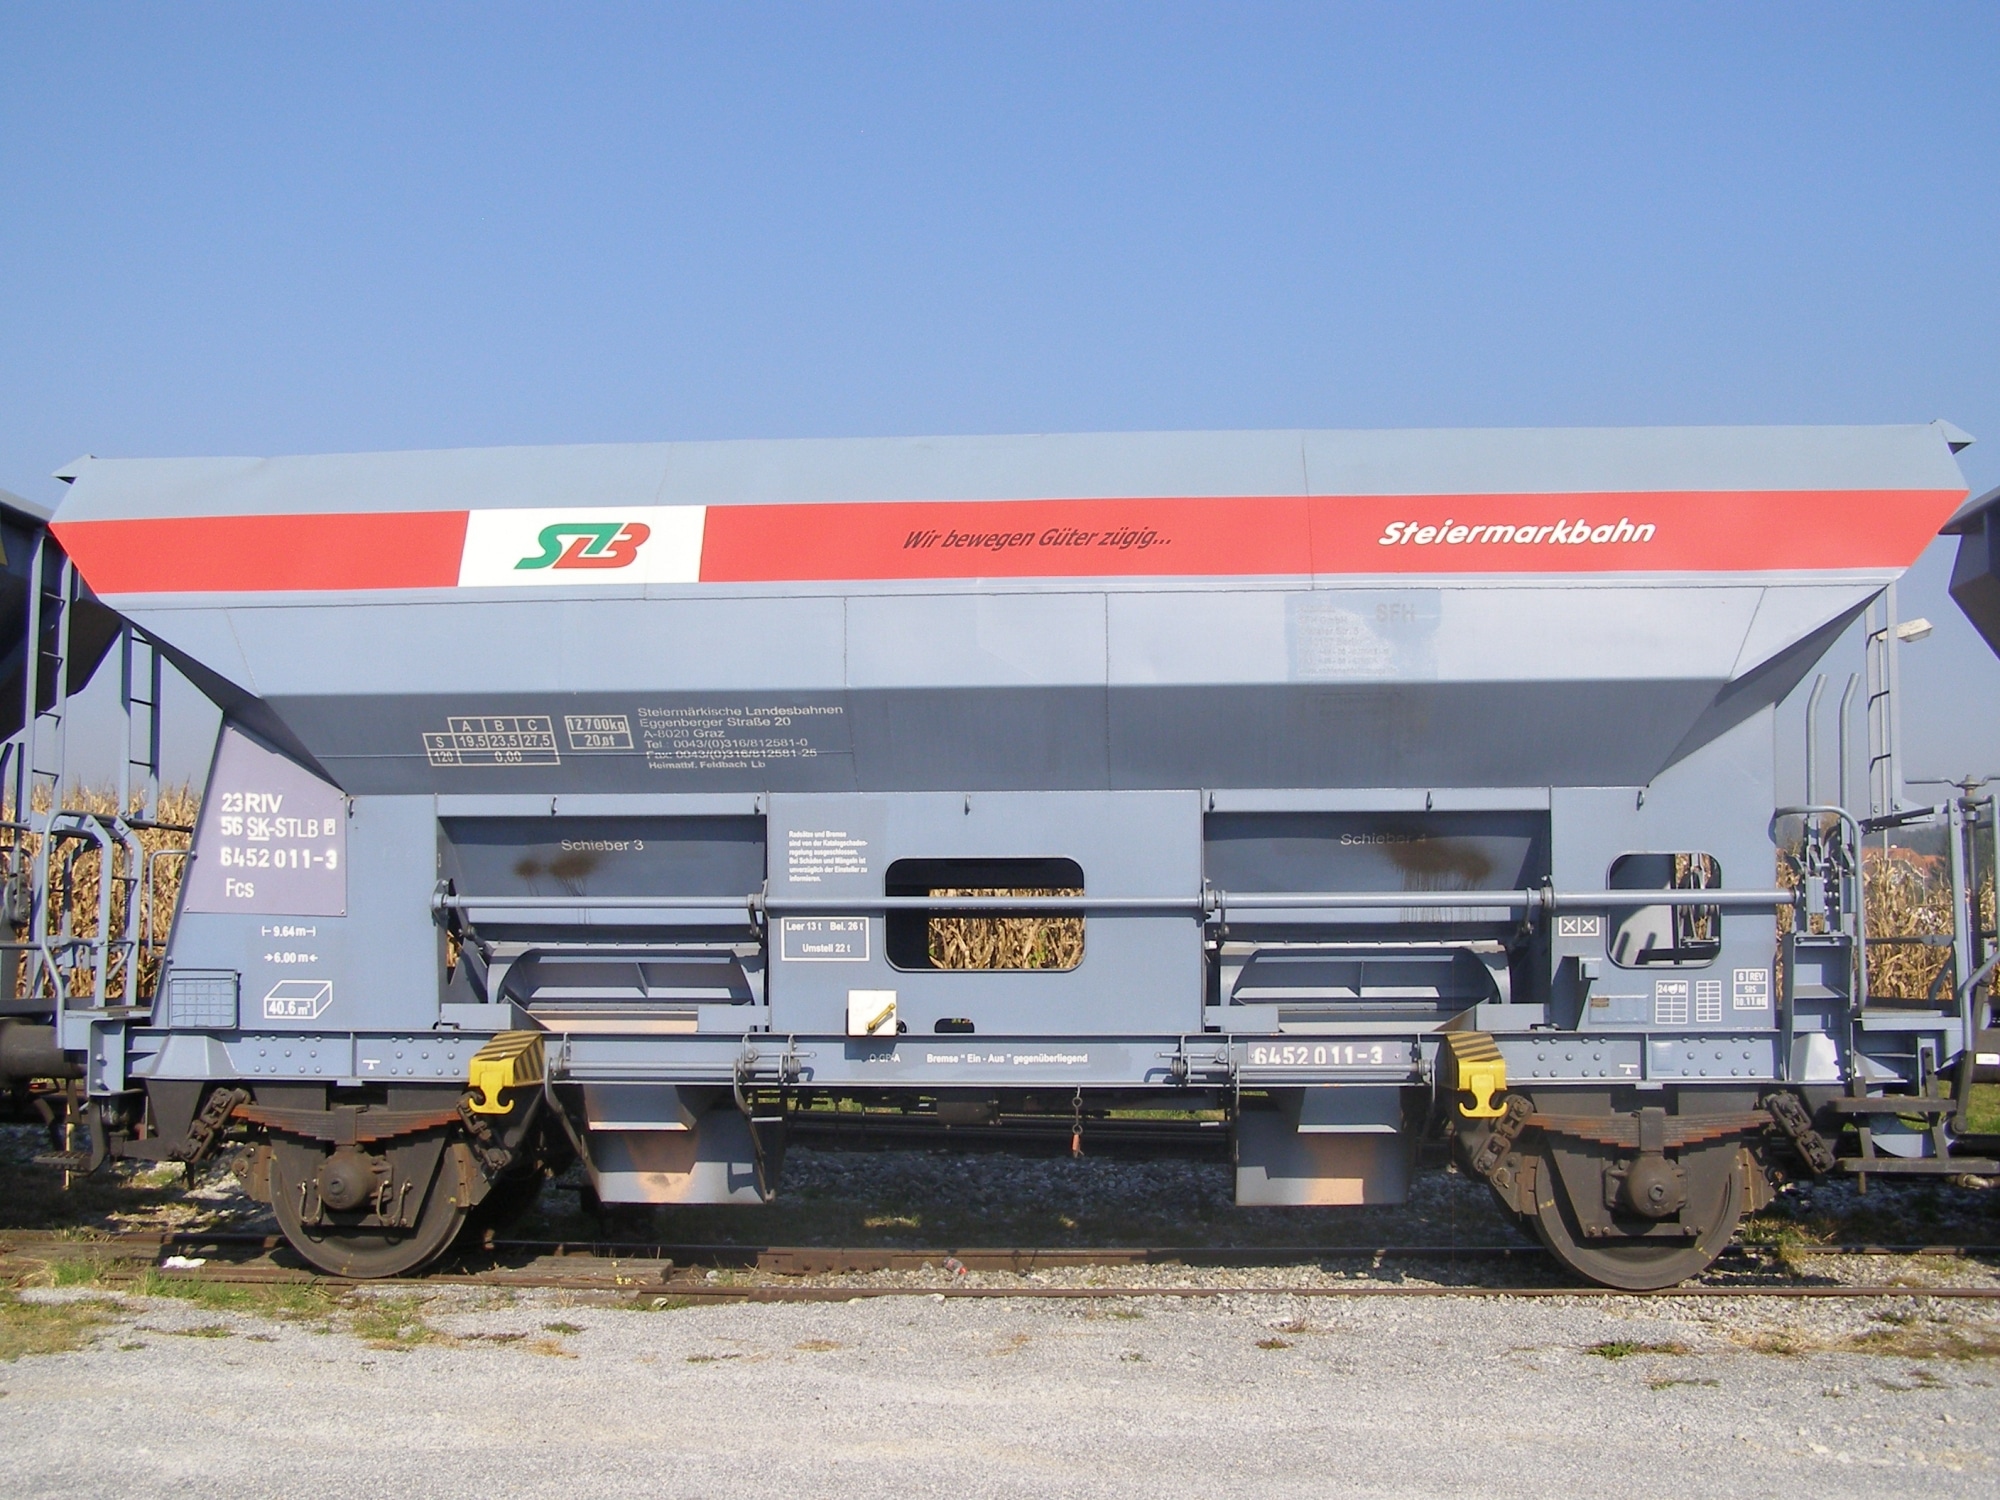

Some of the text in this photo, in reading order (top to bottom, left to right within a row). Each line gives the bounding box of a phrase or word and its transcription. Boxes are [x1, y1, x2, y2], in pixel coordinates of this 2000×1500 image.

[1378, 517, 1656, 546] Steiermarkbahn
[903, 526, 1172, 552] Wir bewegen Güter zügig...
[638, 706, 843, 717] Steiermärkische Landesbahnen
[462, 720, 538, 732] A B C
[640, 717, 791, 729] Eggenberger Straße 20
[643, 729, 725, 738] A-8020 Graz
[435, 735, 551, 748] S 19,5 23,5 27,5
[434, 750, 454, 763] 120
[700, 760, 747, 769] Feldbach
[221, 816, 243, 836] 56
[247, 817, 318, 840] SK-STLB
[561, 839, 644, 851] Schieber 3
[1340, 833, 1411, 845] Schieber
[226, 878, 255, 898] Fcs
[786, 922, 804, 931] Leer
[835, 944, 845, 953] 22
[1750, 972, 1764, 981] REV
[927, 1054, 958, 1063] Bremse
[967, 1054, 981, 1063] Ein
[988, 1054, 1005, 1063] Aus
